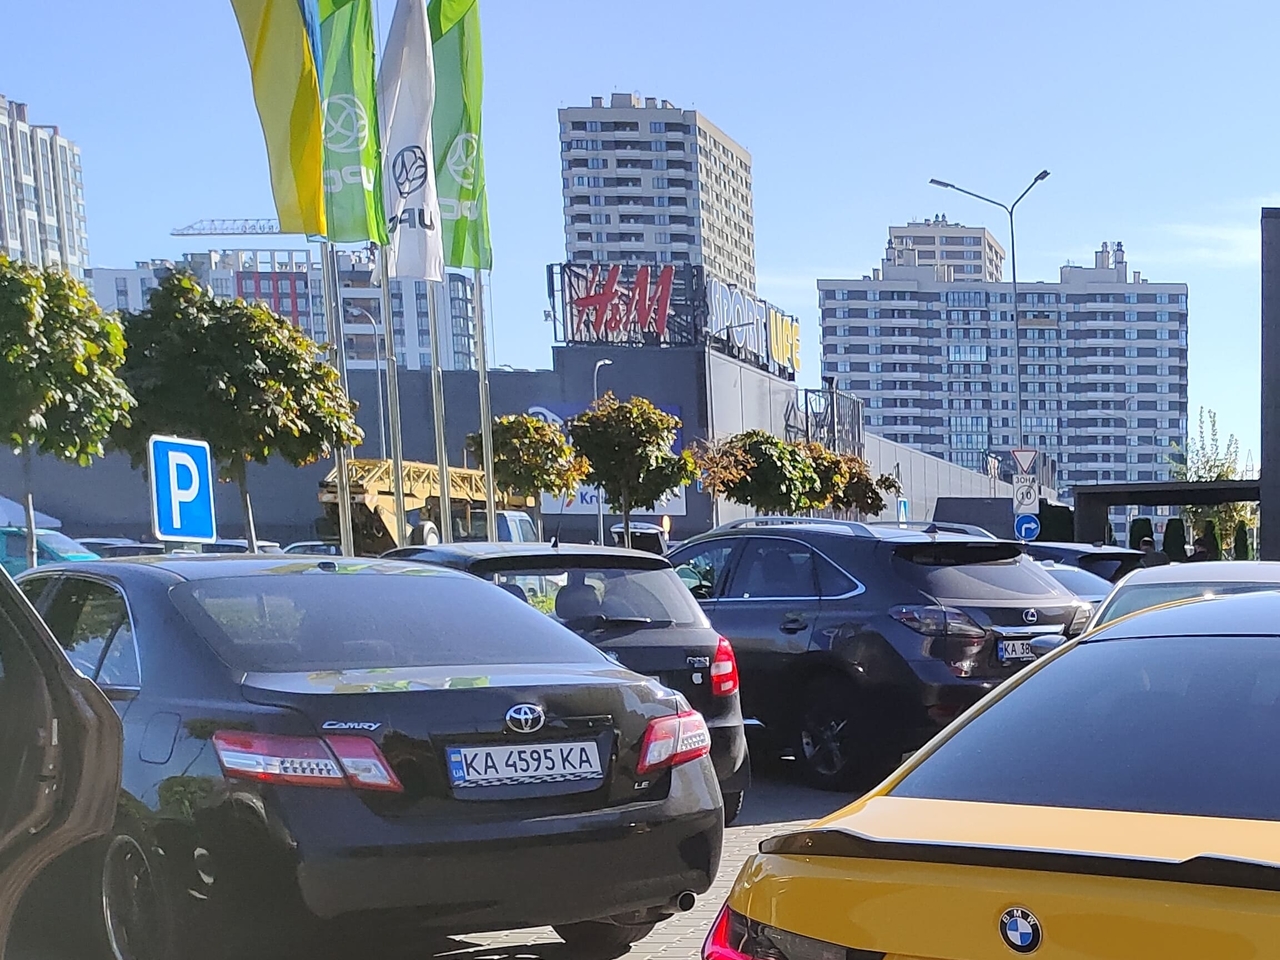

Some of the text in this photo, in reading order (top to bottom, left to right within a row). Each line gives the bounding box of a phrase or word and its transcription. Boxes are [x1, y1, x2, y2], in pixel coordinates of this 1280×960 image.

[574, 265, 675, 335] H&M
[707, 278, 767, 358] SPORT
[1015, 476, 1036, 484] ЗОНА
[167, 450, 200, 529] P
[1020, 491, 1032, 500] 10
[1003, 643, 1017, 656] KA
[464, 747, 593, 777] KA 4595 KA
[453, 769, 464, 777] UA
[634, 780, 649, 790] LE
[1002, 908, 1037, 926] BMW
